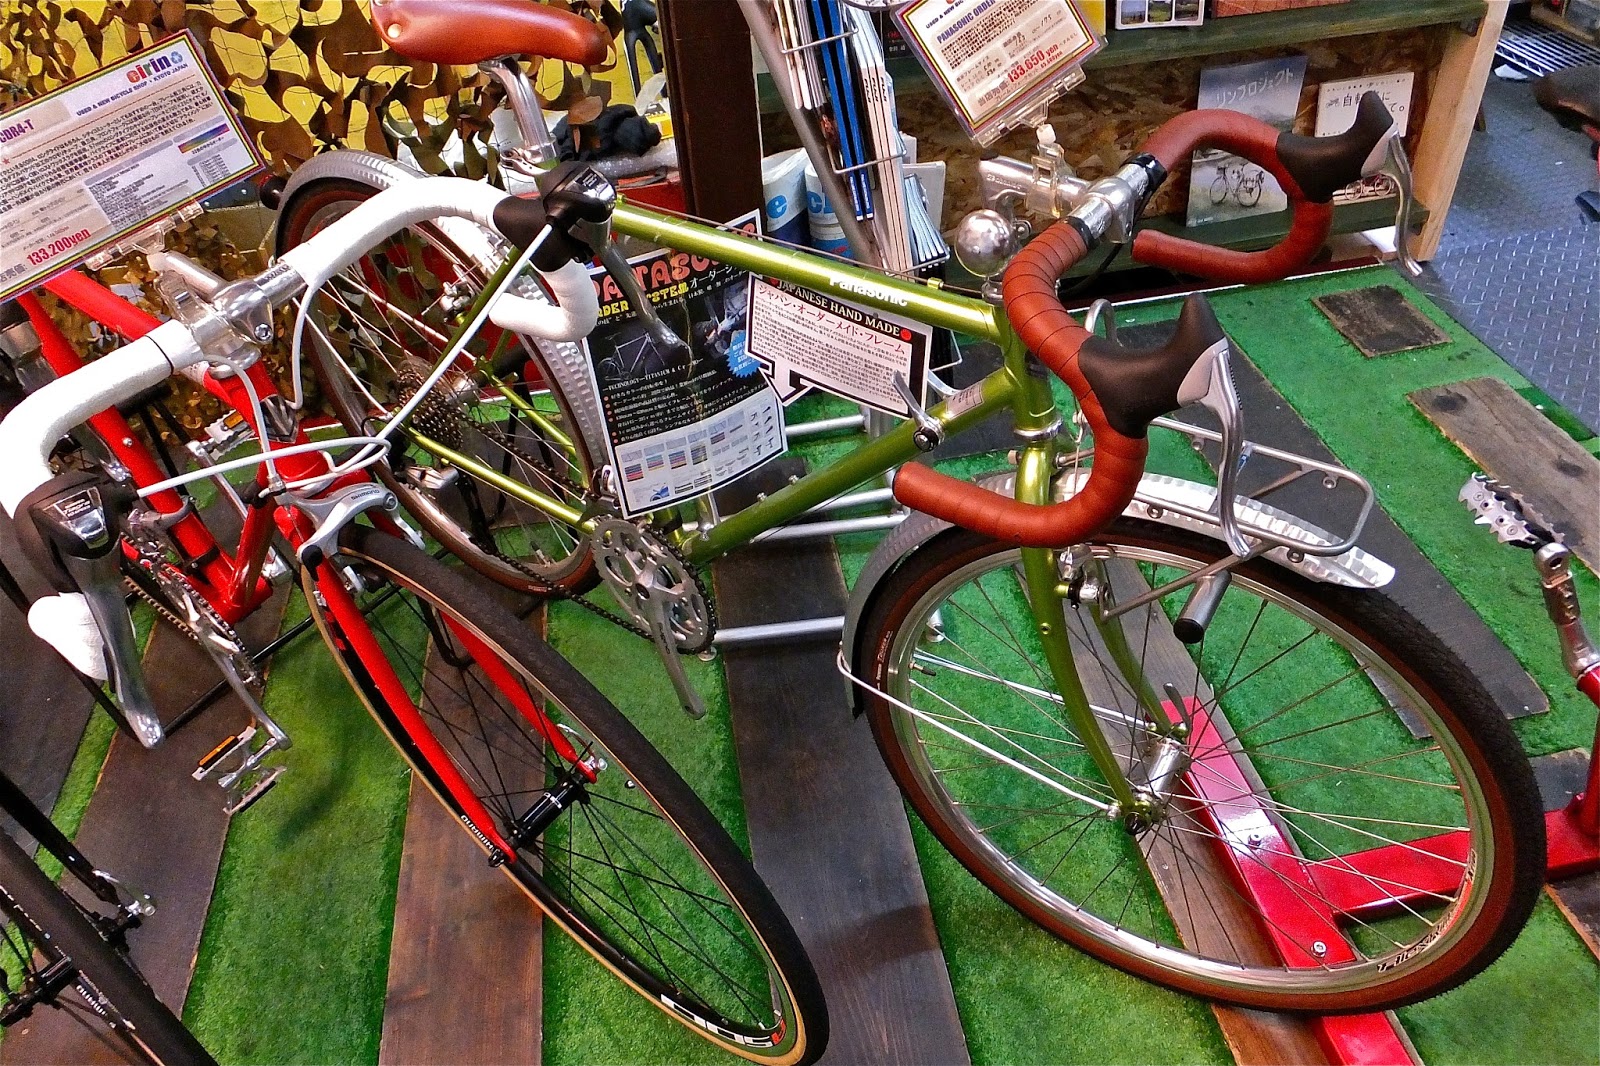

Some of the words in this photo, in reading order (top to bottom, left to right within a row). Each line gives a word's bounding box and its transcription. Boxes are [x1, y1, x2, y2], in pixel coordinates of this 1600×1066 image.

[934, 12, 976, 43] PANASONIC
[1004, 49, 1047, 83] 133.650
[25, 226, 92, 267] 133.200yen
[758, 283, 906, 356] ジャパン・オーダーメイド・フレーム
[777, 279, 829, 309] JAPANESE
[830, 302, 864, 323] HAND
[865, 315, 901, 337] MADE
[459, 812, 495, 852] HIMANO
